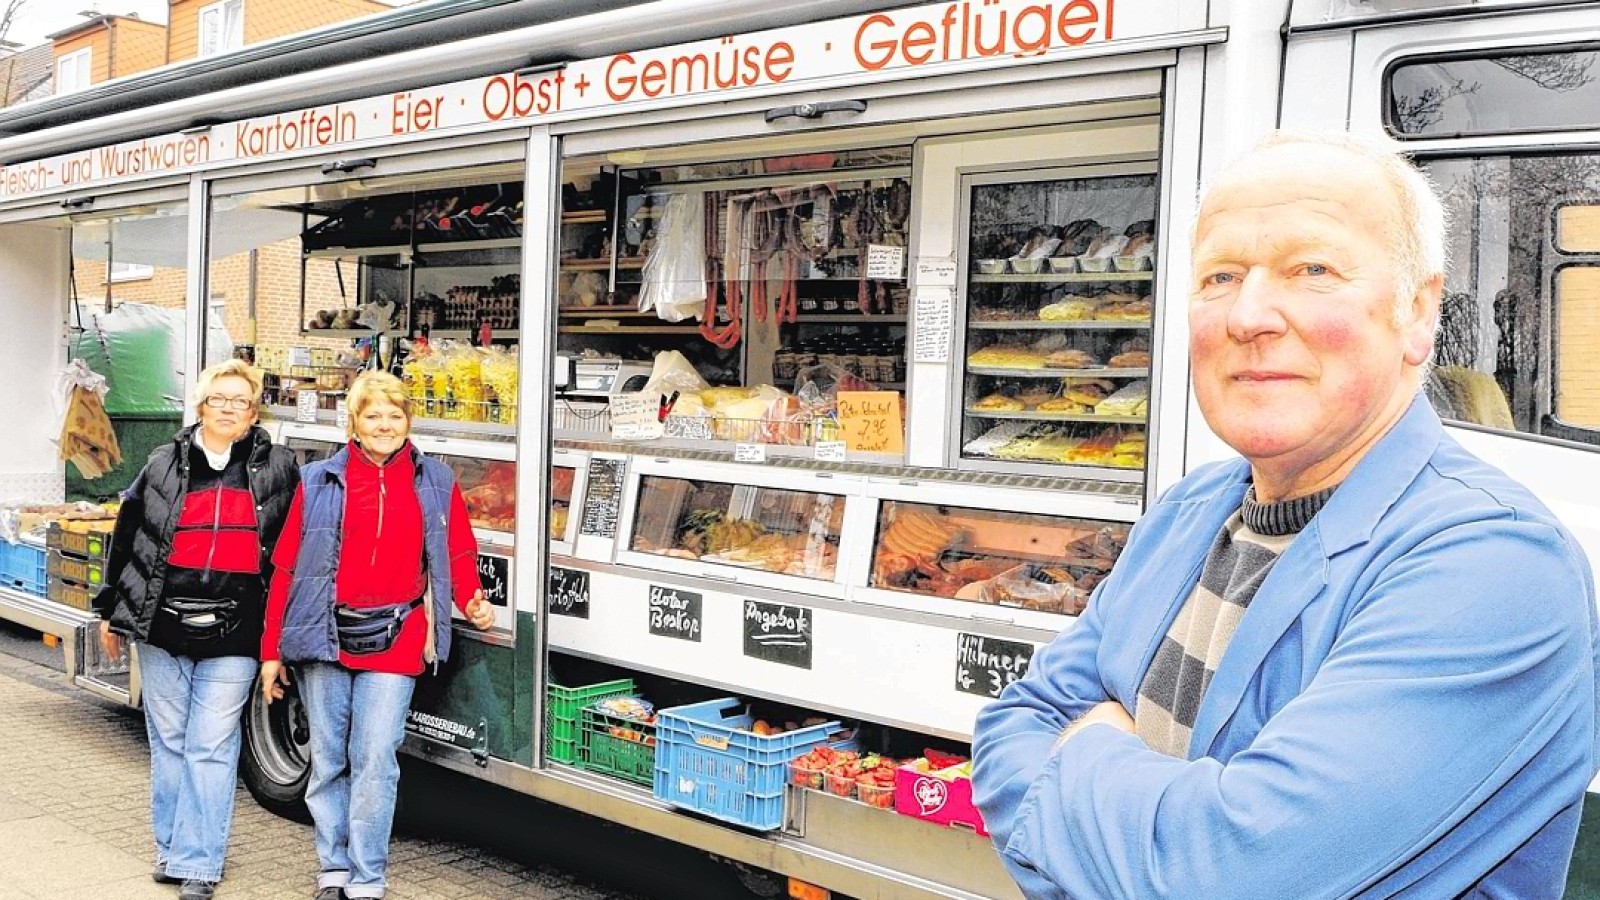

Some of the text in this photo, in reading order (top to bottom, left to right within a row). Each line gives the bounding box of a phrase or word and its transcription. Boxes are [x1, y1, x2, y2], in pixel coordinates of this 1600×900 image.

[61, 150, 92, 184] und
[100, 136, 210, 178] Wurstwaren
[236, 105, 356, 158] Kartoffeln
[392, 92, 444, 135] Eier
[483, 70, 566, 121] Obst
[605, 36, 795, 102] Gemüse
[854, 0, 1115, 71] Geflügel
